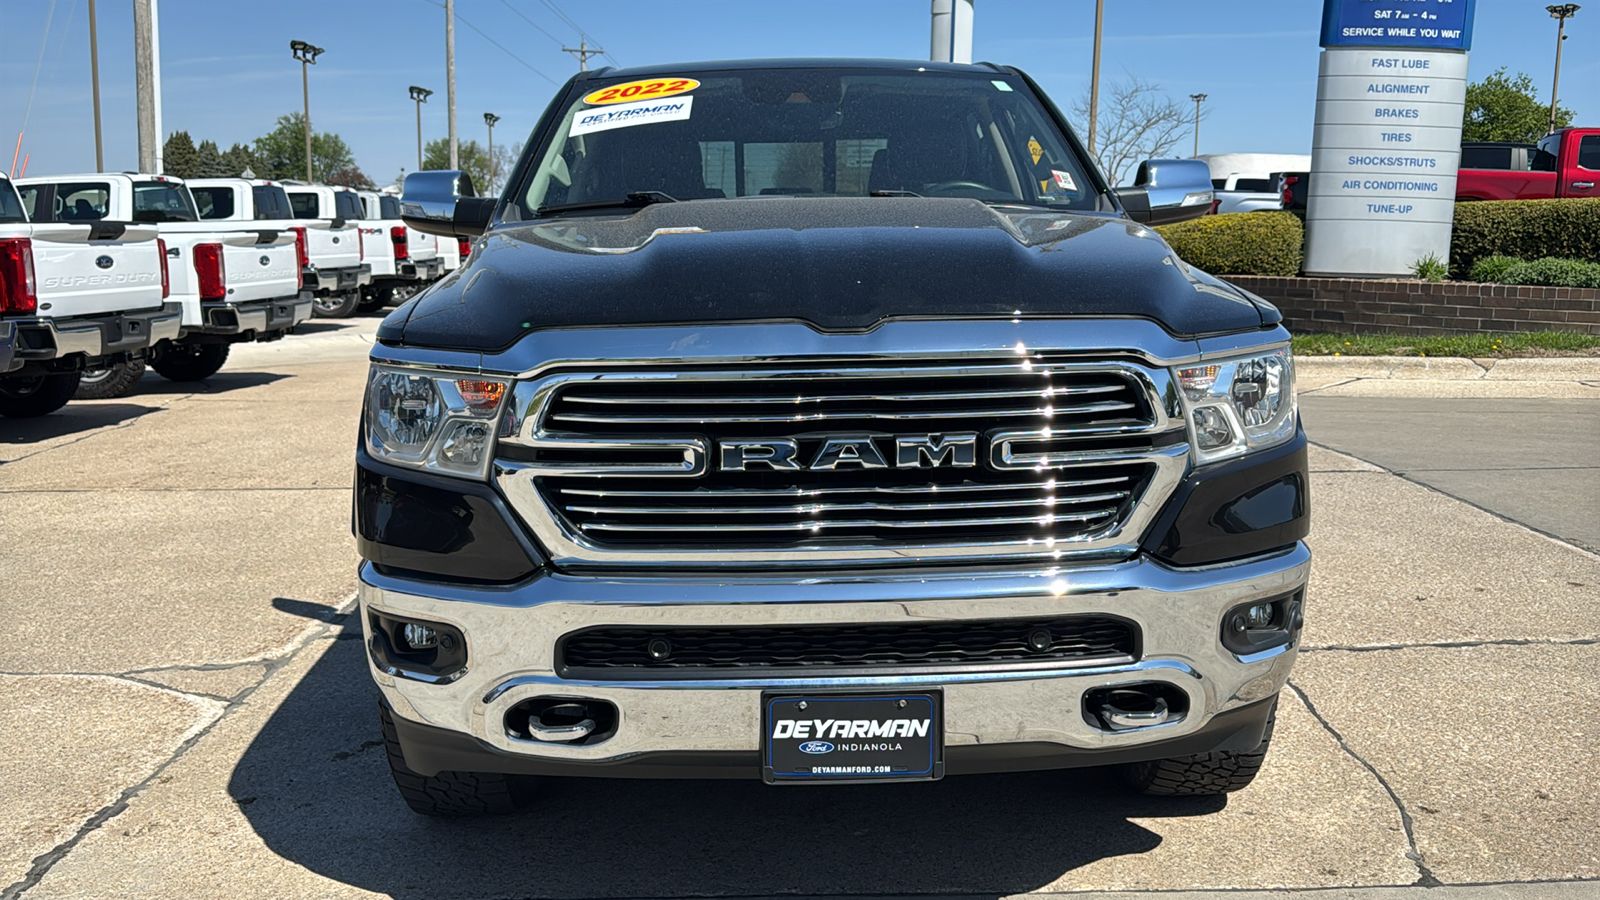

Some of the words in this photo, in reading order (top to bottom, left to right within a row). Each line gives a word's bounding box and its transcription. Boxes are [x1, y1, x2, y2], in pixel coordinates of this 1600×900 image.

[1374, 10, 1392, 18] SAT
[1342, 27, 1384, 36] SERVICE
[1387, 28, 1416, 37] WHILE
[1420, 29, 1438, 38] YOU
[1441, 30, 1461, 39] WAIT
[1371, 59, 1399, 68] FAST
[1402, 59, 1430, 69] LUBE
[594, 80, 689, 102] 2022
[1367, 83, 1430, 94] ALIGNMENT
[579, 103, 685, 125] DEYARMAN
[1374, 108, 1419, 119] BRAKES
[1381, 132, 1412, 142] TIRES
[1348, 156, 1436, 168] SHOCKS/STRUTS
[1342, 180, 1361, 190] AIR
[1363, 180, 1438, 192] CONDITIONING
[1367, 204, 1413, 214] TUNE-UP
[44, 275, 111, 289] SUPER
[115, 271, 157, 284] DUTY
[719, 433, 977, 471] RAM
[772, 719, 931, 739] DEYARMAN
[805, 742, 828, 752] Ford
[837, 743, 902, 751] INDIANOLA
